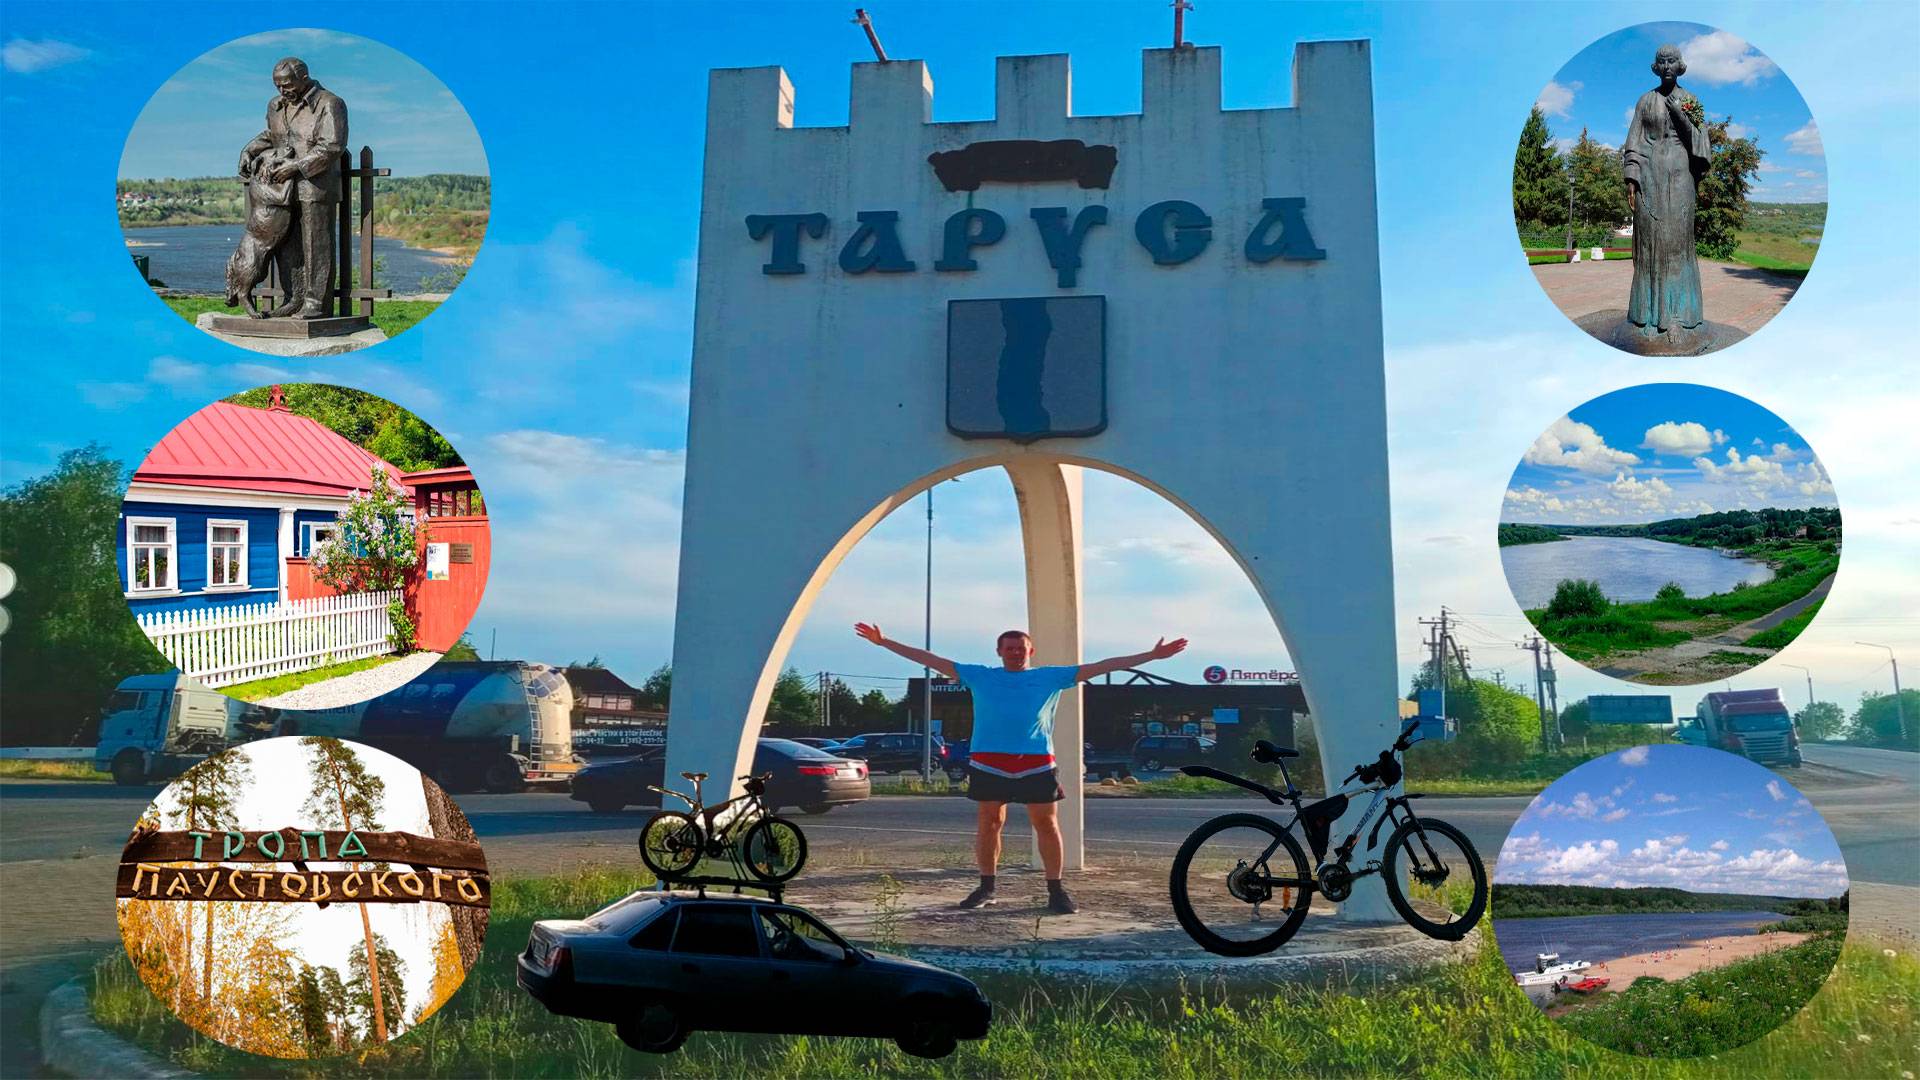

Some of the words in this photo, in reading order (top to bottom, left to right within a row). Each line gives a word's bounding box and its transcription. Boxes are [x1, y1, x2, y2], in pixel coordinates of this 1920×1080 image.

[745, 196, 1327, 289] ТАРУСА
[189, 831, 368, 860] ТРОПА
[131, 863, 483, 902] ПАУСТОВСКОГО
